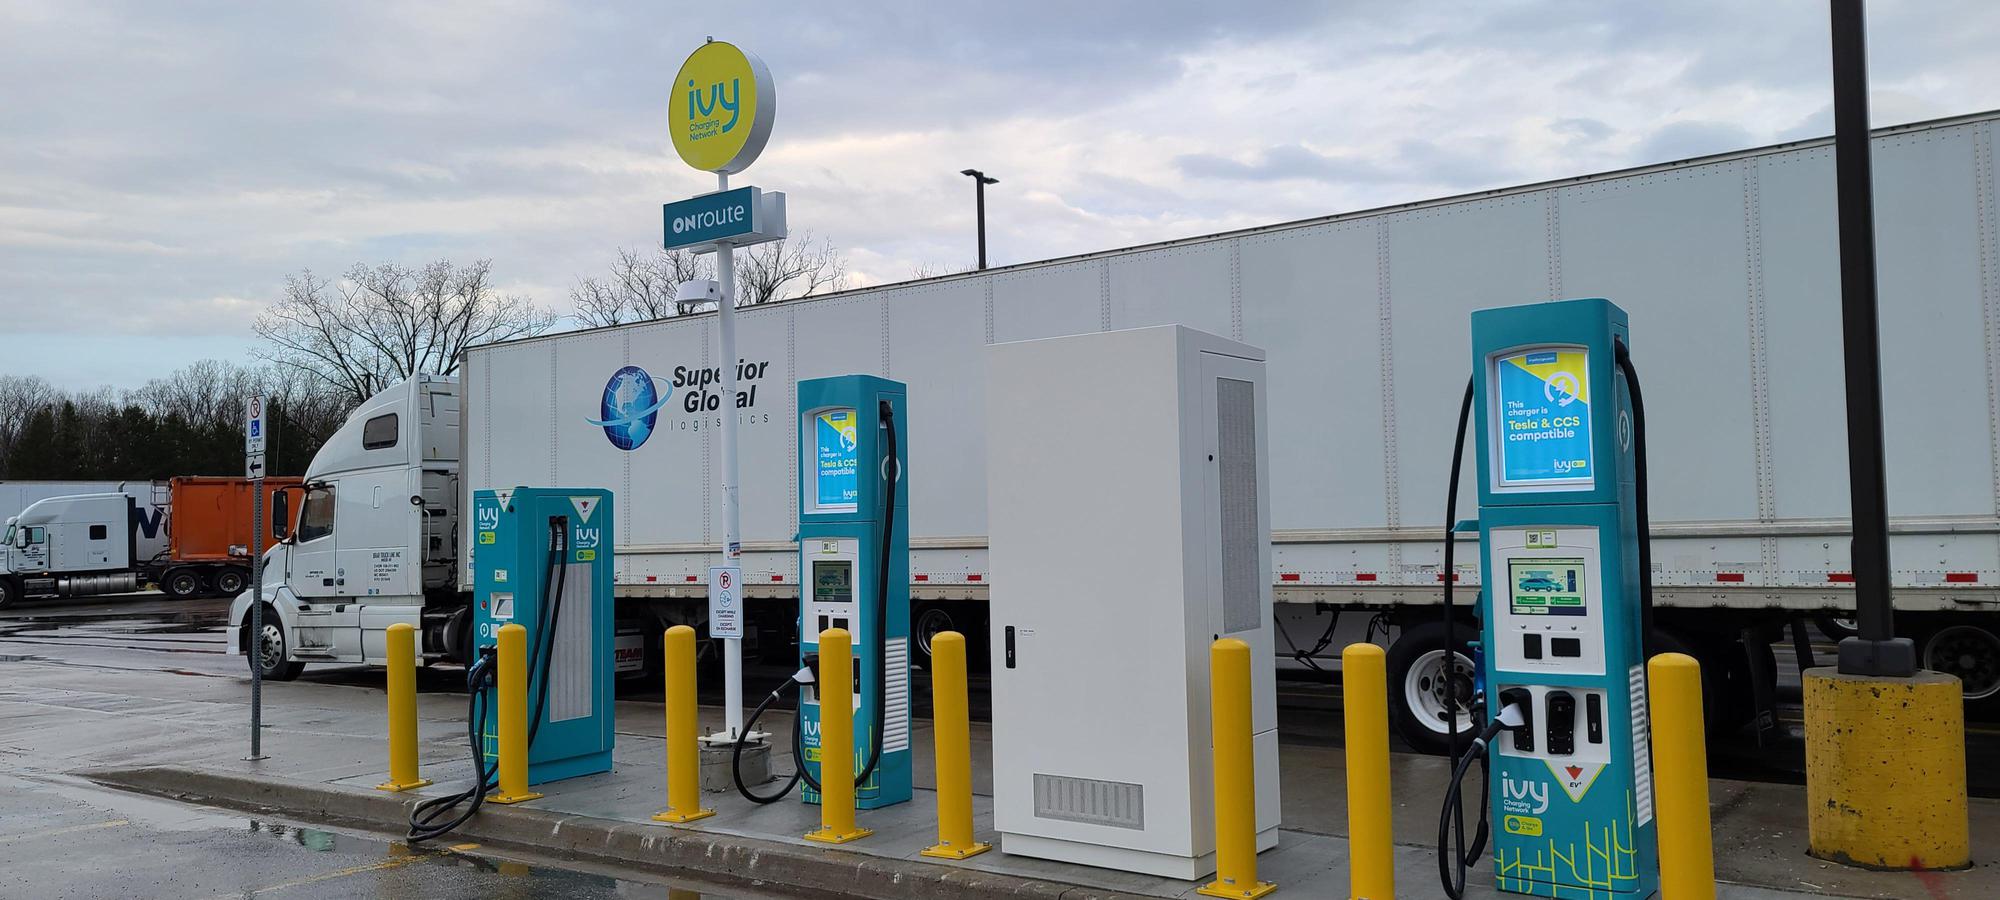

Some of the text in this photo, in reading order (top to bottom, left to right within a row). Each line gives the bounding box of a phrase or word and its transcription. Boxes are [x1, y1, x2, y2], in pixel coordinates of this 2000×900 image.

[688, 78, 740, 134] ivy
[689, 119, 720, 132] Charging
[689, 129, 718, 142] Network
[672, 358, 770, 391] Supeior
[684, 385, 757, 413] Gloal
[1507, 401, 1524, 409] This
[1508, 406, 1548, 417] charger is
[670, 413, 769, 431] logisics
[1508, 416, 1580, 431] Tesla & CCS
[1509, 428, 1575, 442] compatible
[837, 459, 843, 467] &
[1554, 459, 1571, 472] ivy
[820, 467, 855, 477] compatible
[479, 503, 499, 530] ivy
[576, 524, 599, 548] ivy
[1502, 771, 1549, 814] ivy
[1503, 799, 1531, 809] Charging
[1503, 805, 1530, 814] Network
